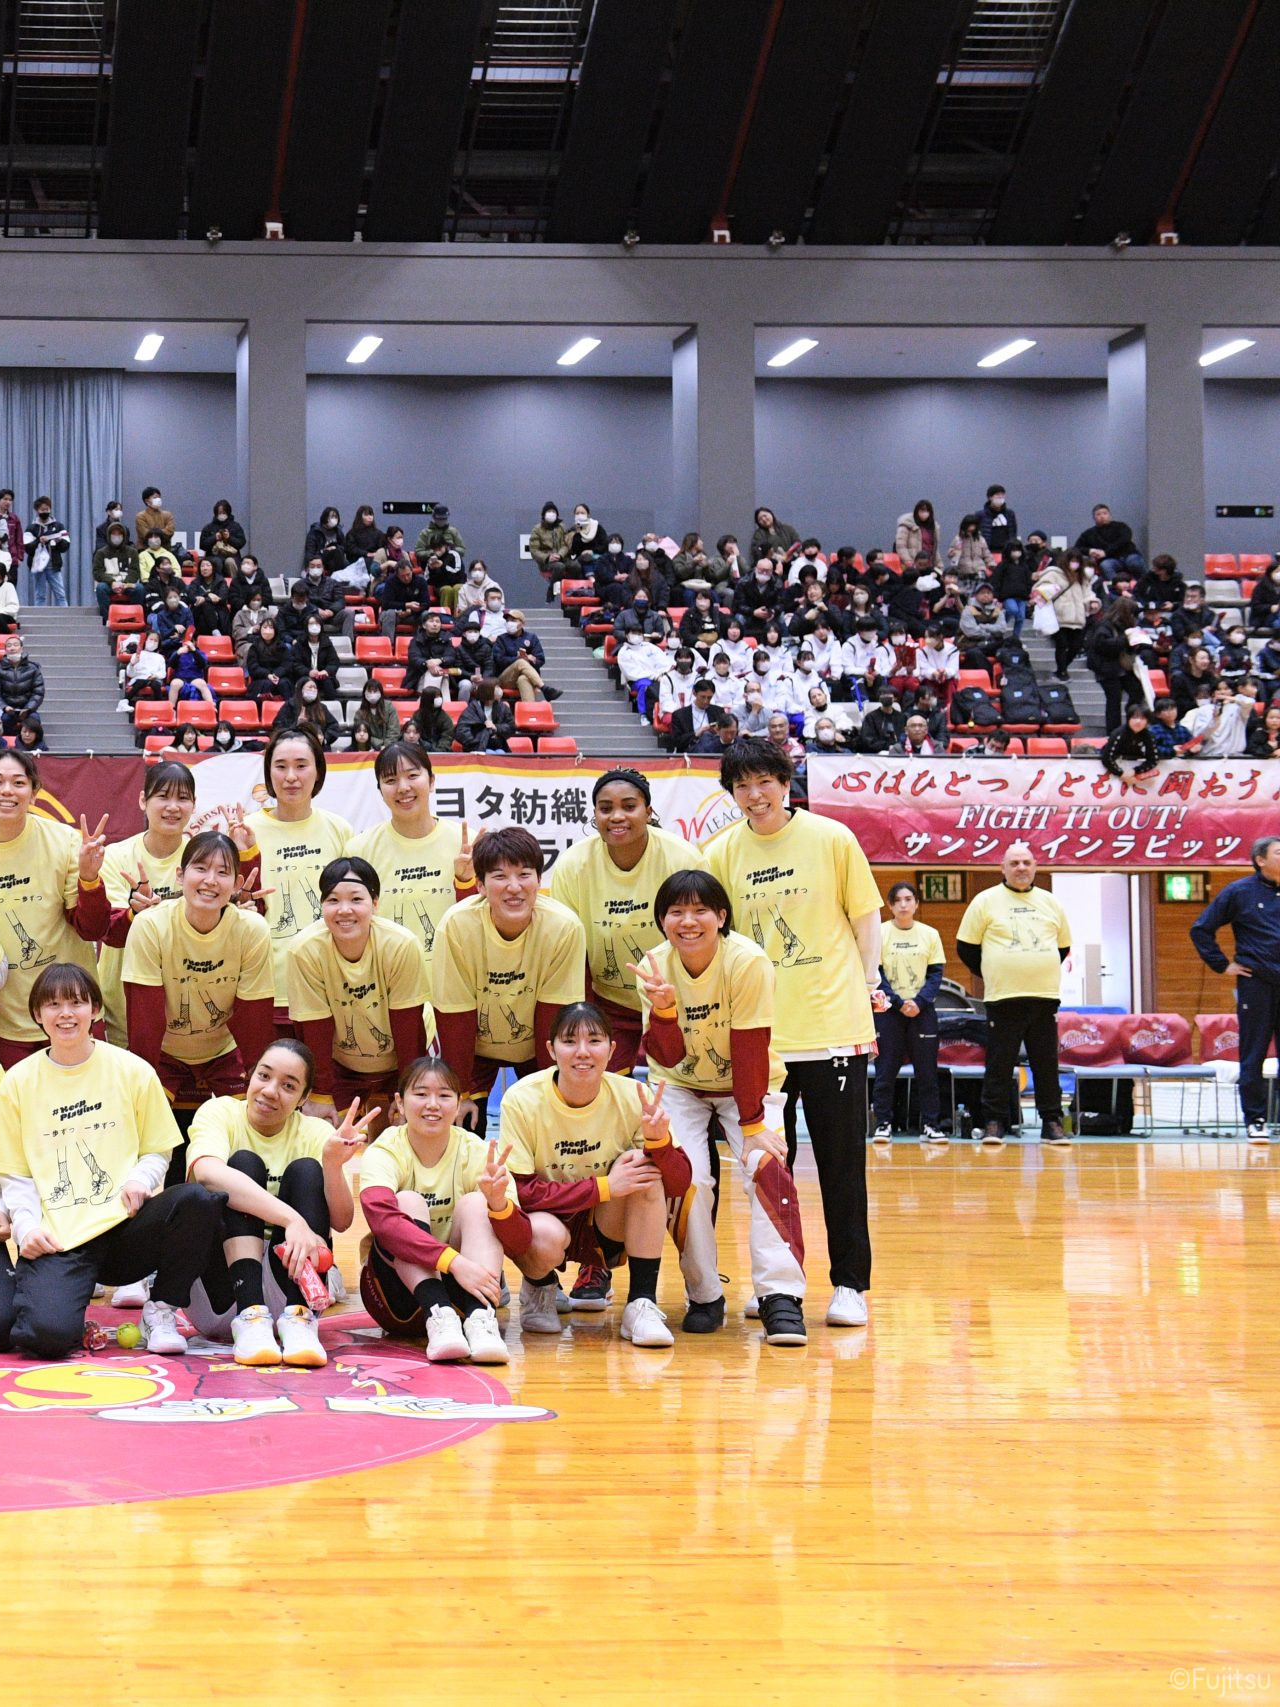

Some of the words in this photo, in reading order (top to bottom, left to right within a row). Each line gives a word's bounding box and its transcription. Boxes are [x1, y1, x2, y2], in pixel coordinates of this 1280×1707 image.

[435, 785, 588, 825] ヨタ紡織
[956, 804, 1058, 830] FIGHT
[1062, 804, 1101, 830] IT
[1107, 804, 1189, 830] OUT!
[277, 845, 306, 855] #Keep
[284, 847, 321, 859] Playing
[395, 866, 426, 876] #Keep
[401, 869, 441, 881] Playing
[746, 866, 778, 880] #Keep
[752, 868, 794, 885] Playing
[604, 899, 633, 909] #Keep
[608, 901, 648, 915] Playing
[187, 959, 224, 973] Playing
[838, 1076, 846, 1092] 7
[52, 1100, 86, 1116] #Keep
[60, 1101, 101, 1121] Playing
[554, 1139, 587, 1150] #Keep
[560, 1140, 601, 1156] Playing
